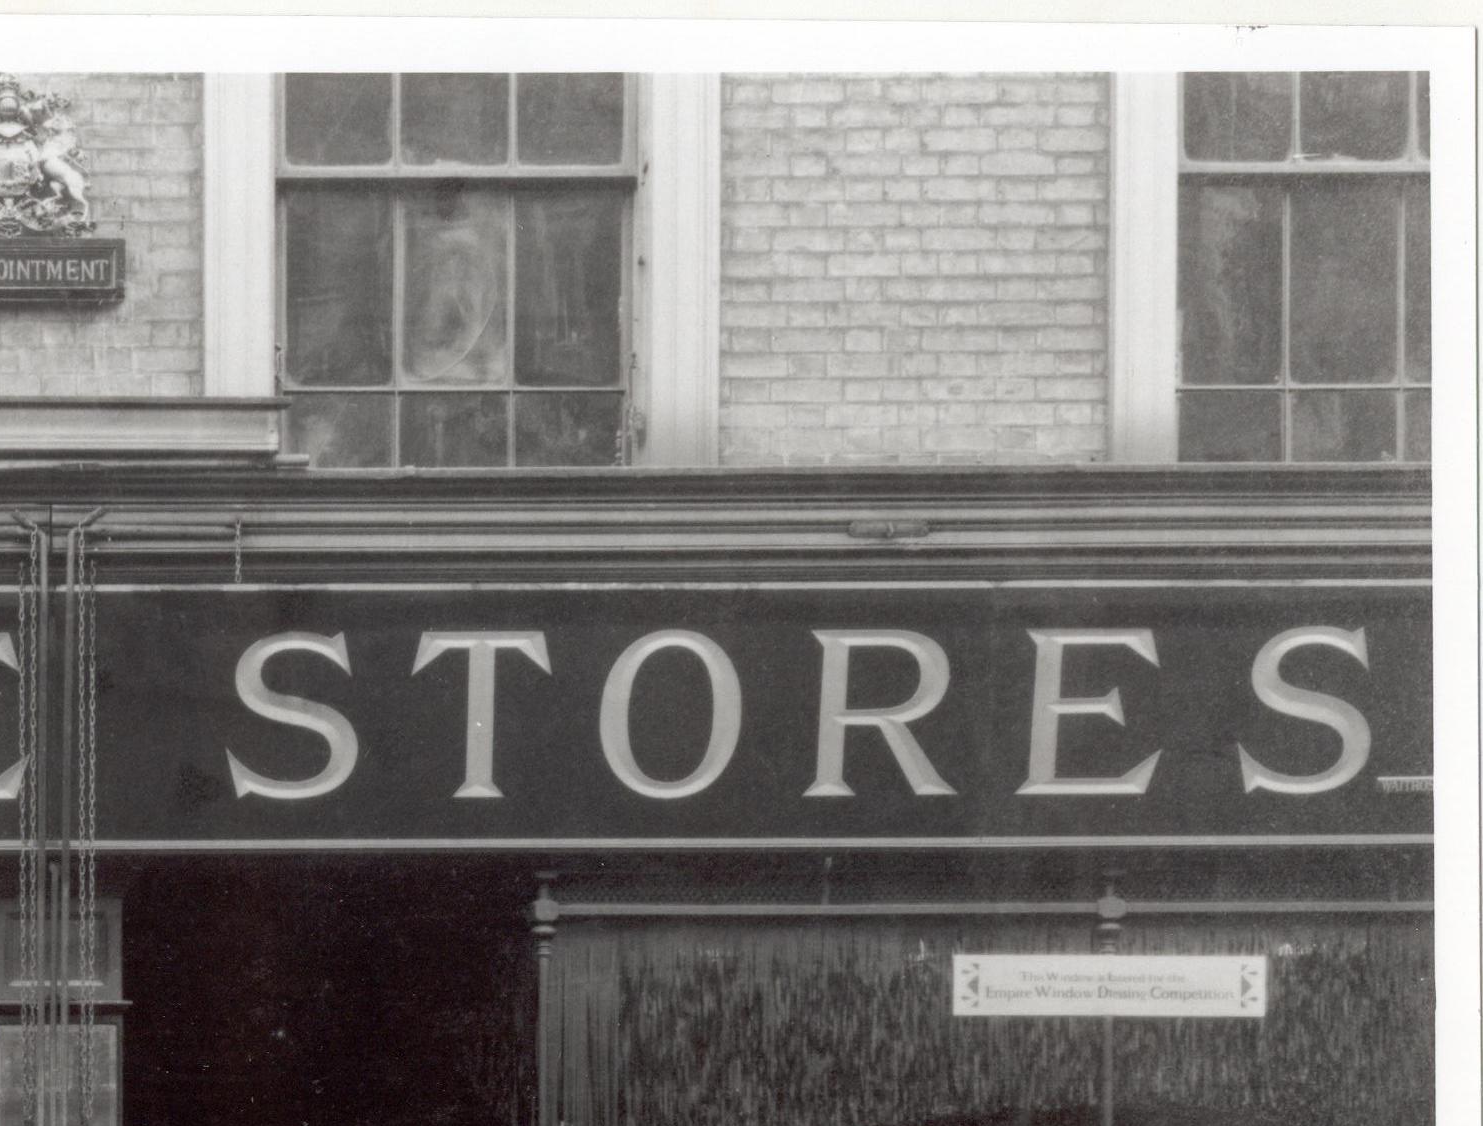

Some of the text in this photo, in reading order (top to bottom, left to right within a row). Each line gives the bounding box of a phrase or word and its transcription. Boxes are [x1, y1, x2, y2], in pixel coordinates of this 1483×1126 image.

[226, 625, 1372, 799] STORES
[1046, 971, 1095, 982] Window
[985, 985, 1235, 1002] Empire Window Dressing Competition
